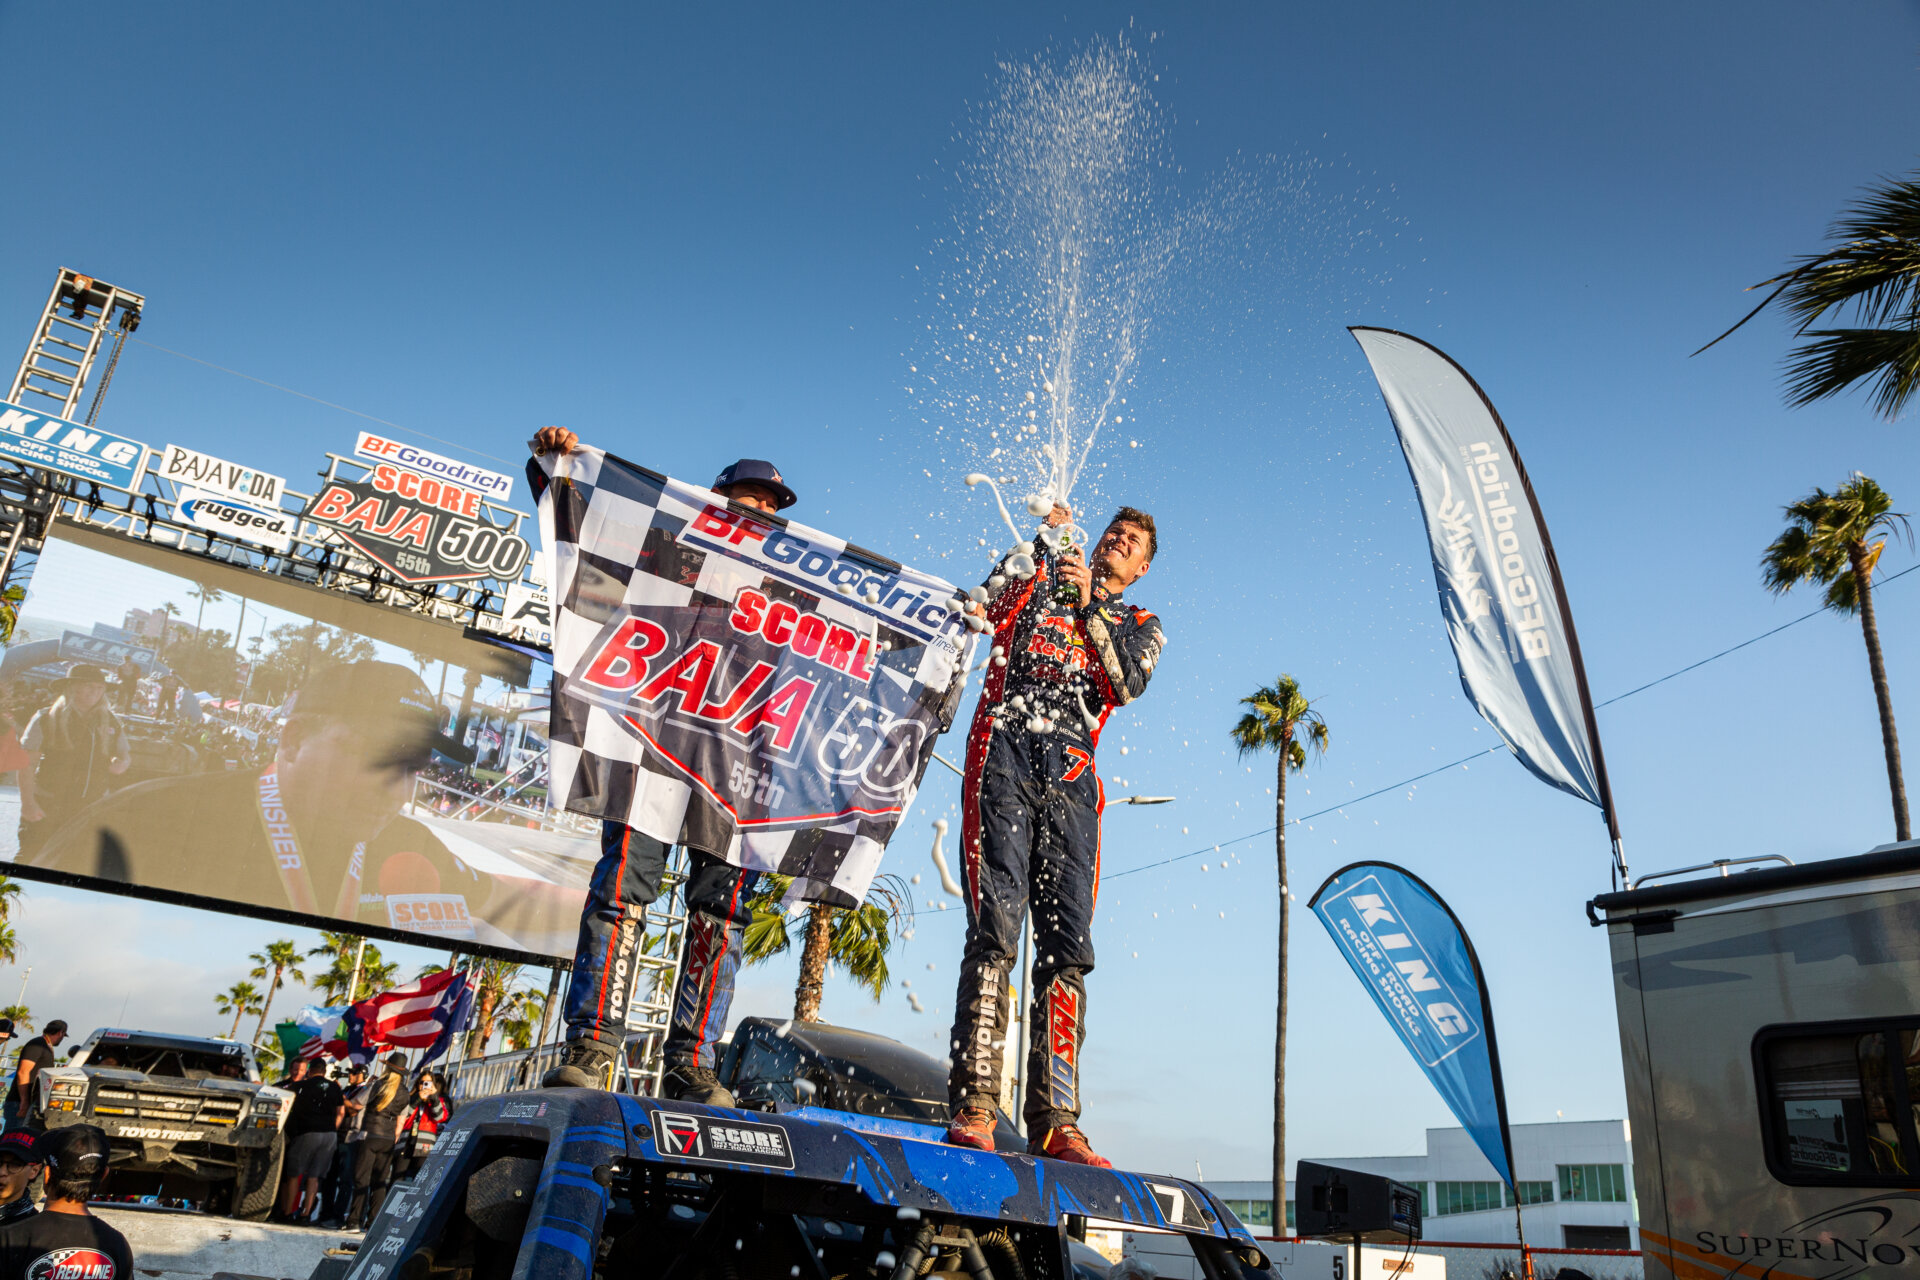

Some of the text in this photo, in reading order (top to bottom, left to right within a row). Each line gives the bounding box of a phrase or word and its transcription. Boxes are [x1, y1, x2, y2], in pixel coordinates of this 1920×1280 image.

[0, 408, 139, 465] KING
[0, 442, 54, 463] RACING
[19, 440, 49, 454] OFF
[58, 450, 101, 468] ROAD
[168, 447, 222, 485] BAJA
[361, 435, 508, 494] BFGoodrich
[373, 464, 481, 519] SCORE
[310, 486, 527, 576] BAJA 500
[395, 551, 431, 576] 55th
[691, 503, 966, 637] BFGoodrich
[64, 636, 152, 663] KING
[731, 590, 881, 682] SCORE
[931, 634, 956, 654] Tires
[1027, 633, 1072, 664] Red
[580, 614, 928, 791] BAJA 50
[728, 760, 784, 809] 55th
[1062, 746, 1090, 782] 7
[260, 773, 301, 870] FINISHER
[395, 902, 468, 922] SCORE
[610, 958, 628, 1020] TOYO
[674, 911, 716, 1031] AMSOIL
[1340, 918, 1422, 1036] RACING SHOCKS
[1351, 893, 1468, 1036] KING
[1360, 931, 1382, 959] OFF
[1386, 971, 1419, 1017] ROAD
[975, 966, 1000, 1088] TOYO TIRES
[1047, 975, 1078, 1111] AMSOIL
[118, 1126, 205, 1141] TOYO TIRES
[710, 1127, 782, 1148] SCORE
[1152, 1184, 1185, 1224] 7
[55, 1264, 112, 1280] RED LINE
[1333, 1256, 1344, 1280] 5
